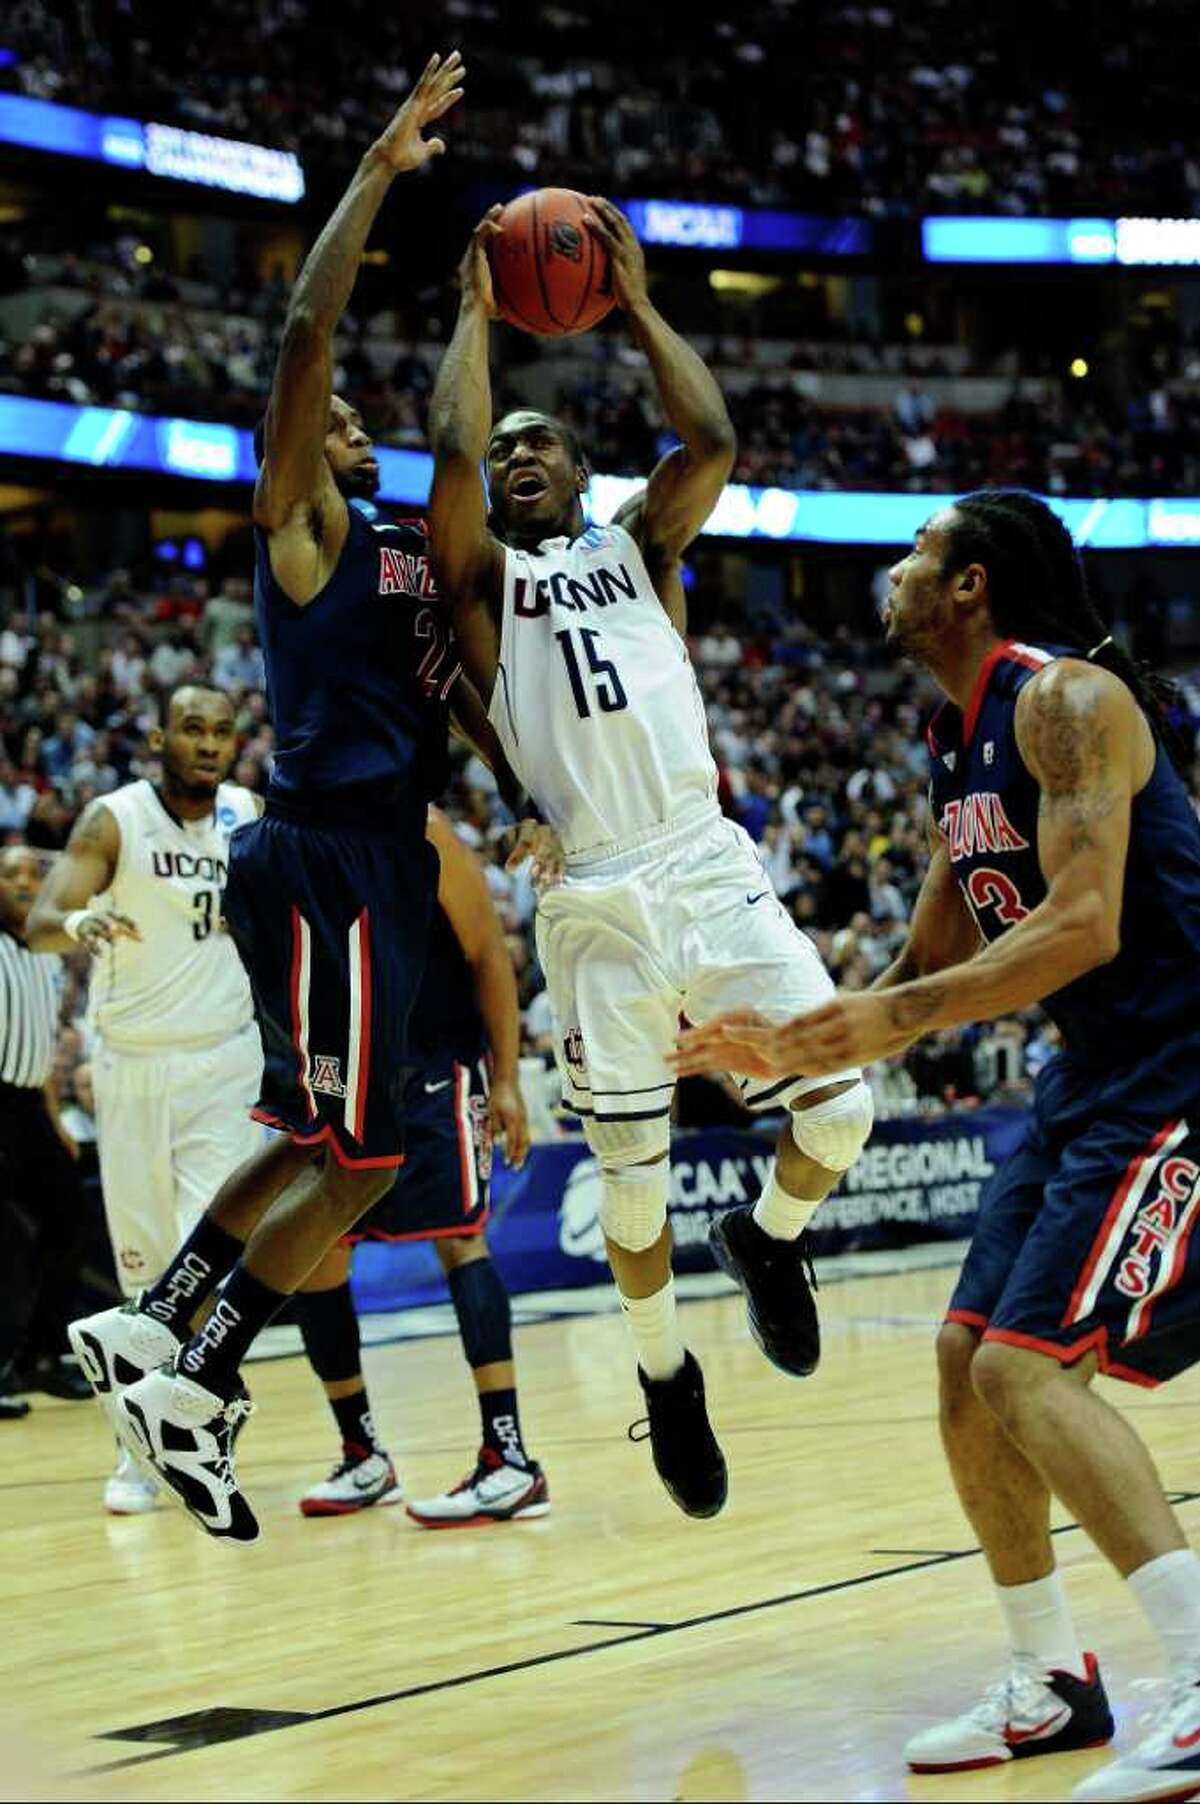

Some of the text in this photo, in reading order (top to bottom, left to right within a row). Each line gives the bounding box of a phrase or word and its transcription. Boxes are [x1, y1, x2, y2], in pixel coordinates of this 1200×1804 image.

[555, 627, 628, 718] 15
[152, 852, 228, 883] UCON
[309, 1054, 348, 1098] A
[671, 1157, 750, 1209] CAA
[1114, 1157, 1199, 1298] CATS
[147, 1252, 211, 1321] CATS
[184, 1299, 242, 1373] CATS
